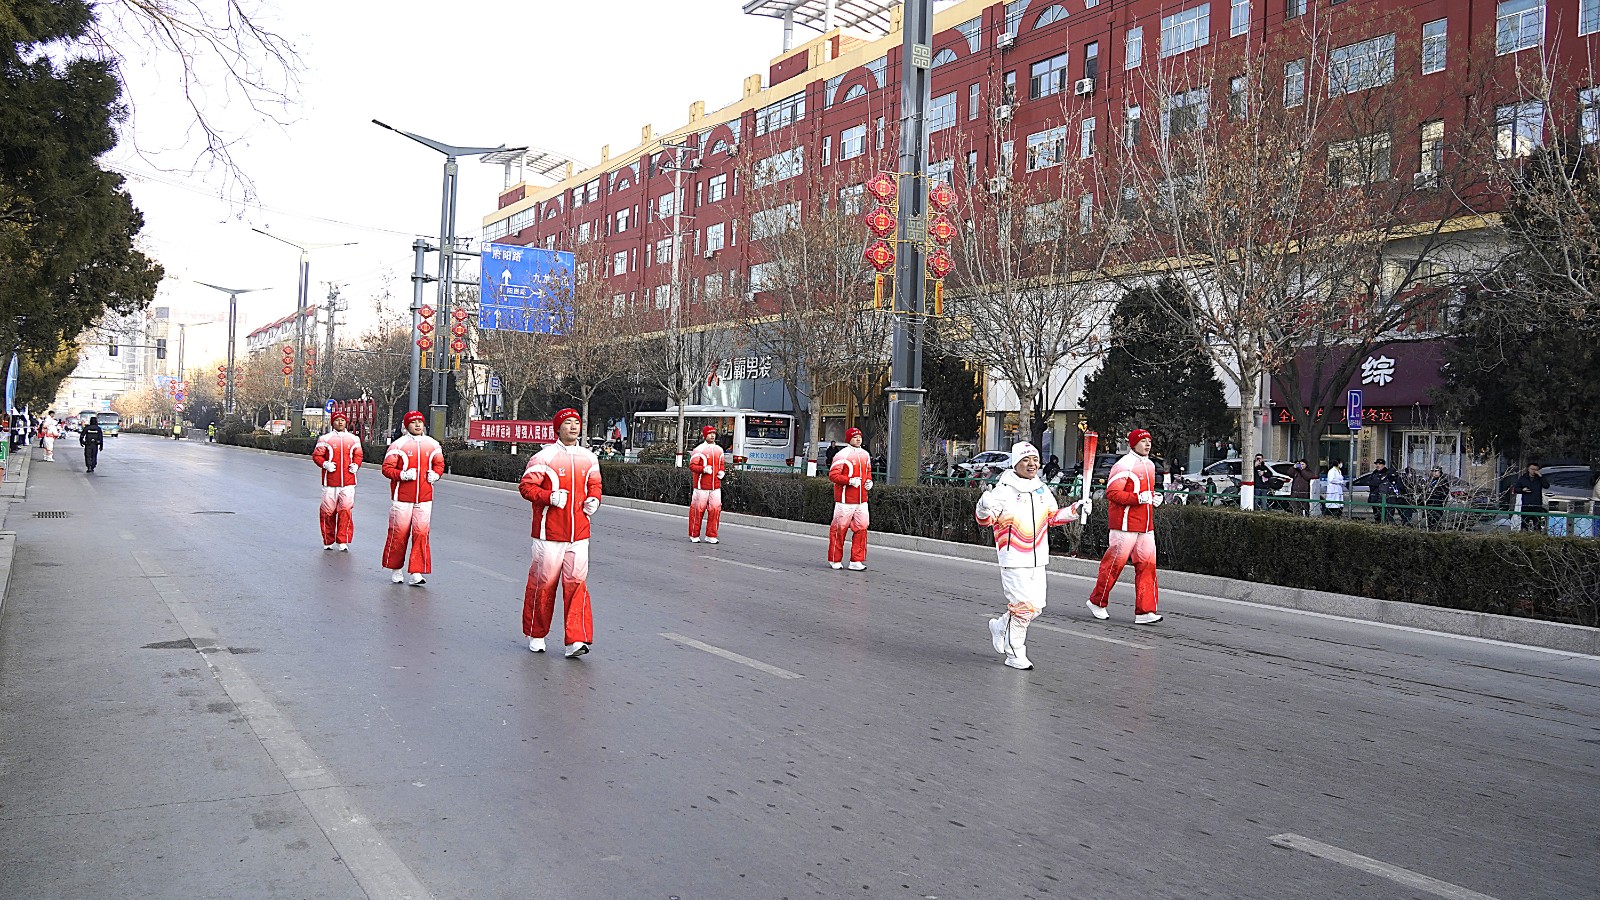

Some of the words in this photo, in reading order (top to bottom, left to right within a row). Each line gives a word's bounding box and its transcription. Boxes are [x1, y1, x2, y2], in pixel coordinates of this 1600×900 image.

[1361, 354, 1396, 387] 综
[1350, 392, 1361, 418] P
[515, 425, 555, 441] 增强人民体质
